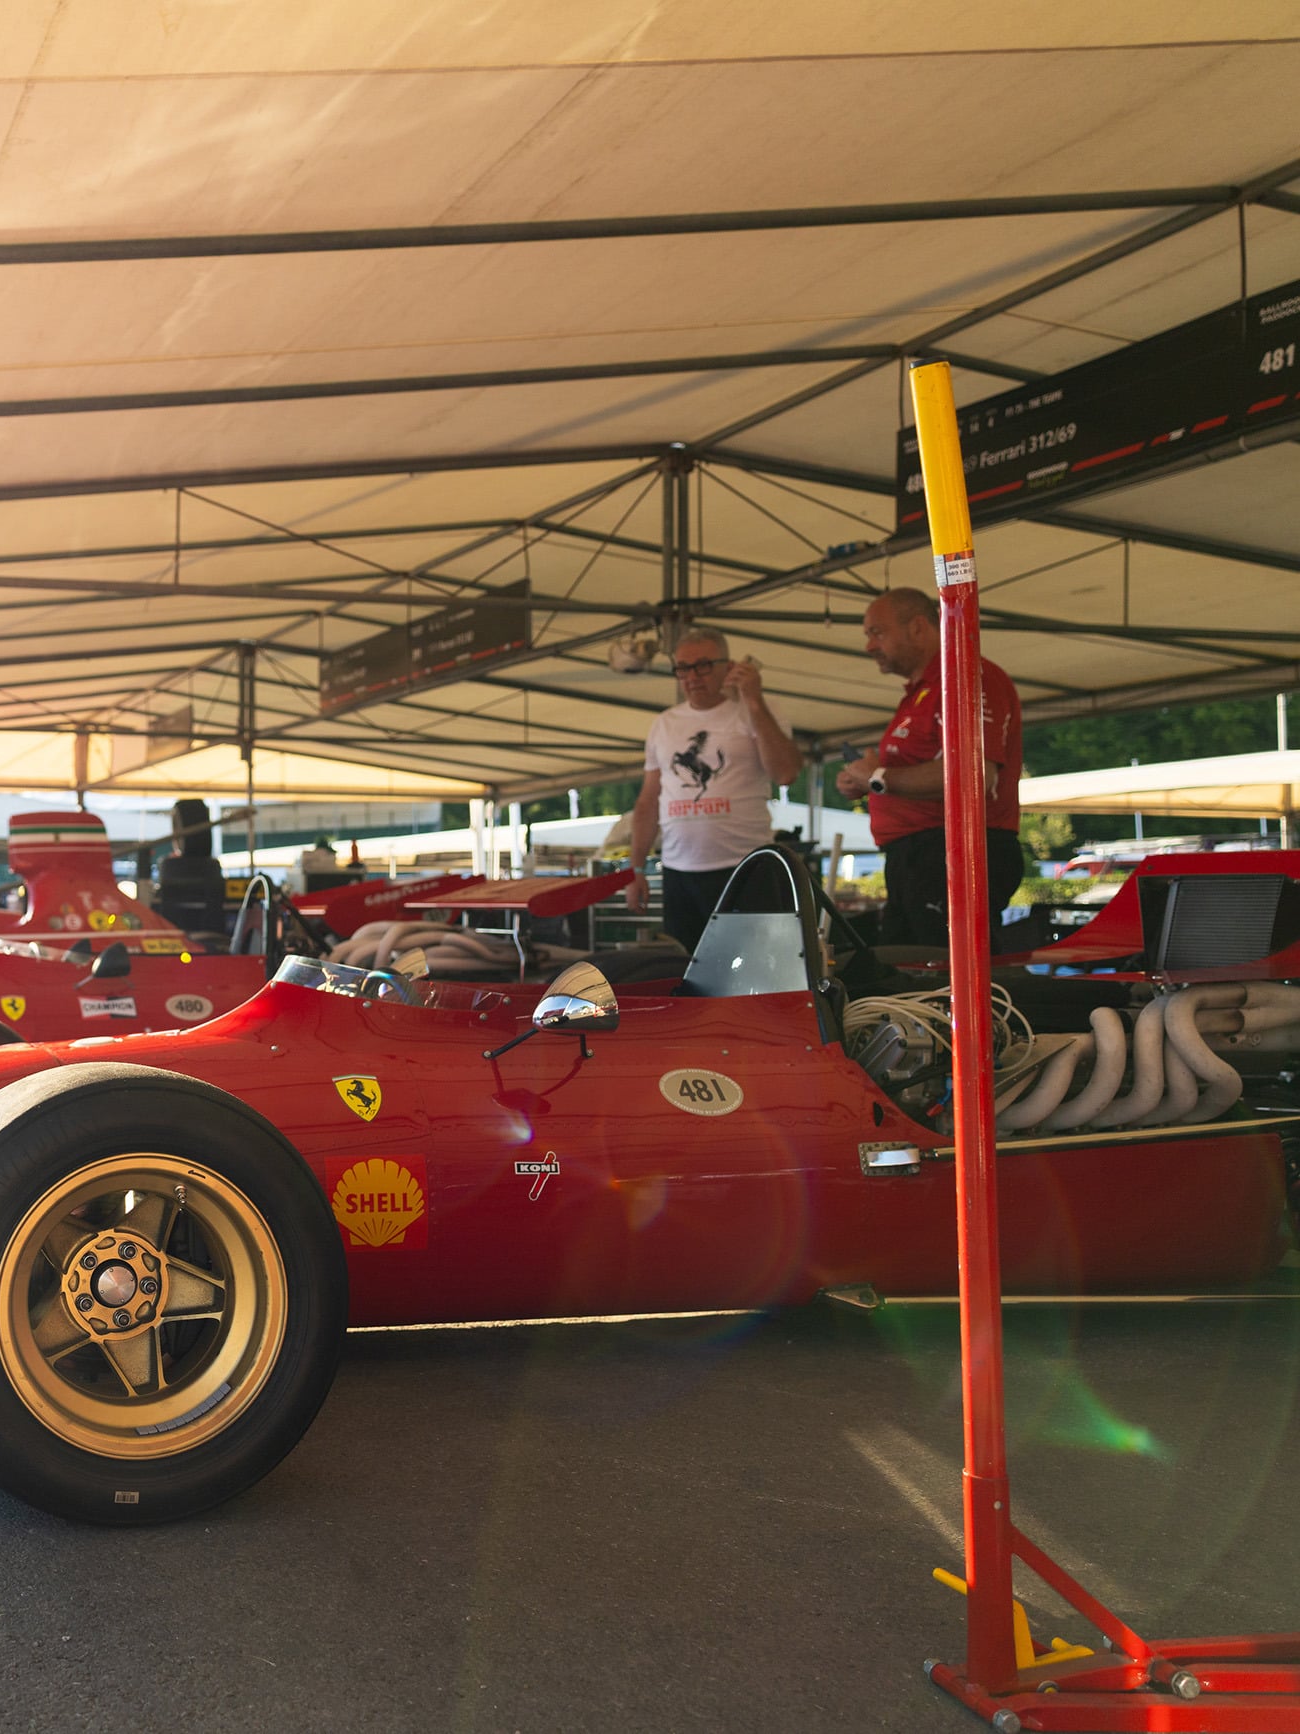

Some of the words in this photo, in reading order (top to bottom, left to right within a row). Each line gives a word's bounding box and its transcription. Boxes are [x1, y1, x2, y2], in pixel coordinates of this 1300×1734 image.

[1259, 343, 1295, 374] 481
[980, 439, 1026, 469] Ferrari
[1028, 422, 1077, 454] 312/69
[83, 1002, 133, 1012] CHAMPION
[175, 999, 203, 1013] 480
[679, 1079, 726, 1102] 481
[520, 1164, 556, 1172] KONI
[346, 1193, 413, 1214] SHELL
